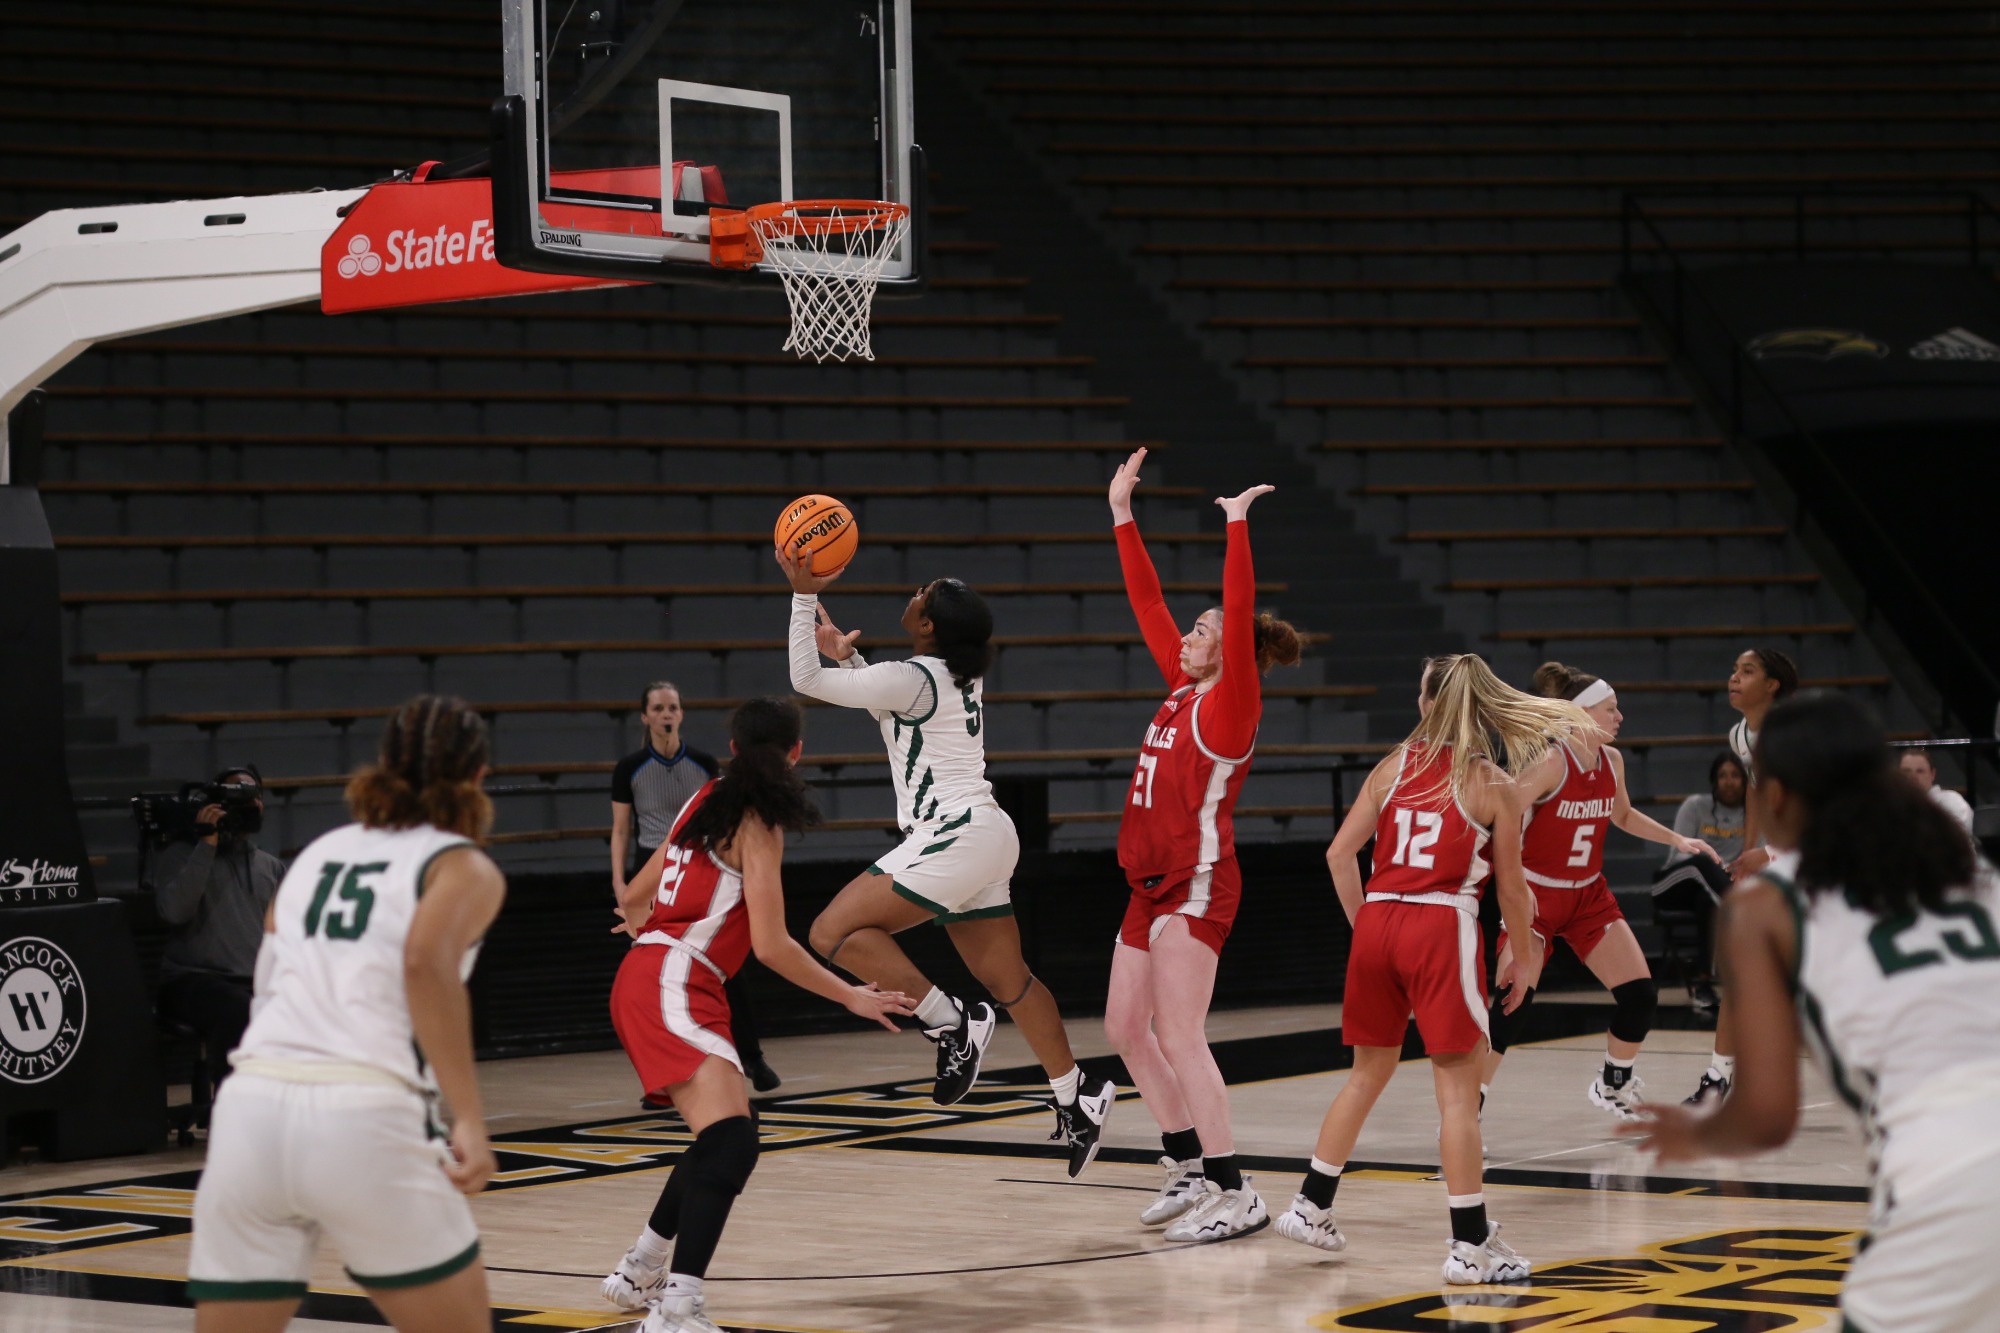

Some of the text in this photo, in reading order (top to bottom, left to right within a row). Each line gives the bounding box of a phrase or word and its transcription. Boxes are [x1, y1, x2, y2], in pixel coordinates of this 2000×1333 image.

[540, 231, 582, 247] SPALDING
[795, 511, 846, 548] Wilson
[1391, 807, 1443, 870] 12
[1567, 824, 1596, 867] 5
[0, 887, 77, 902] SINO
[304, 861, 391, 940] 15
[0, 944, 77, 995] NCOCK
[0, 1018, 78, 1076] HITNEY
